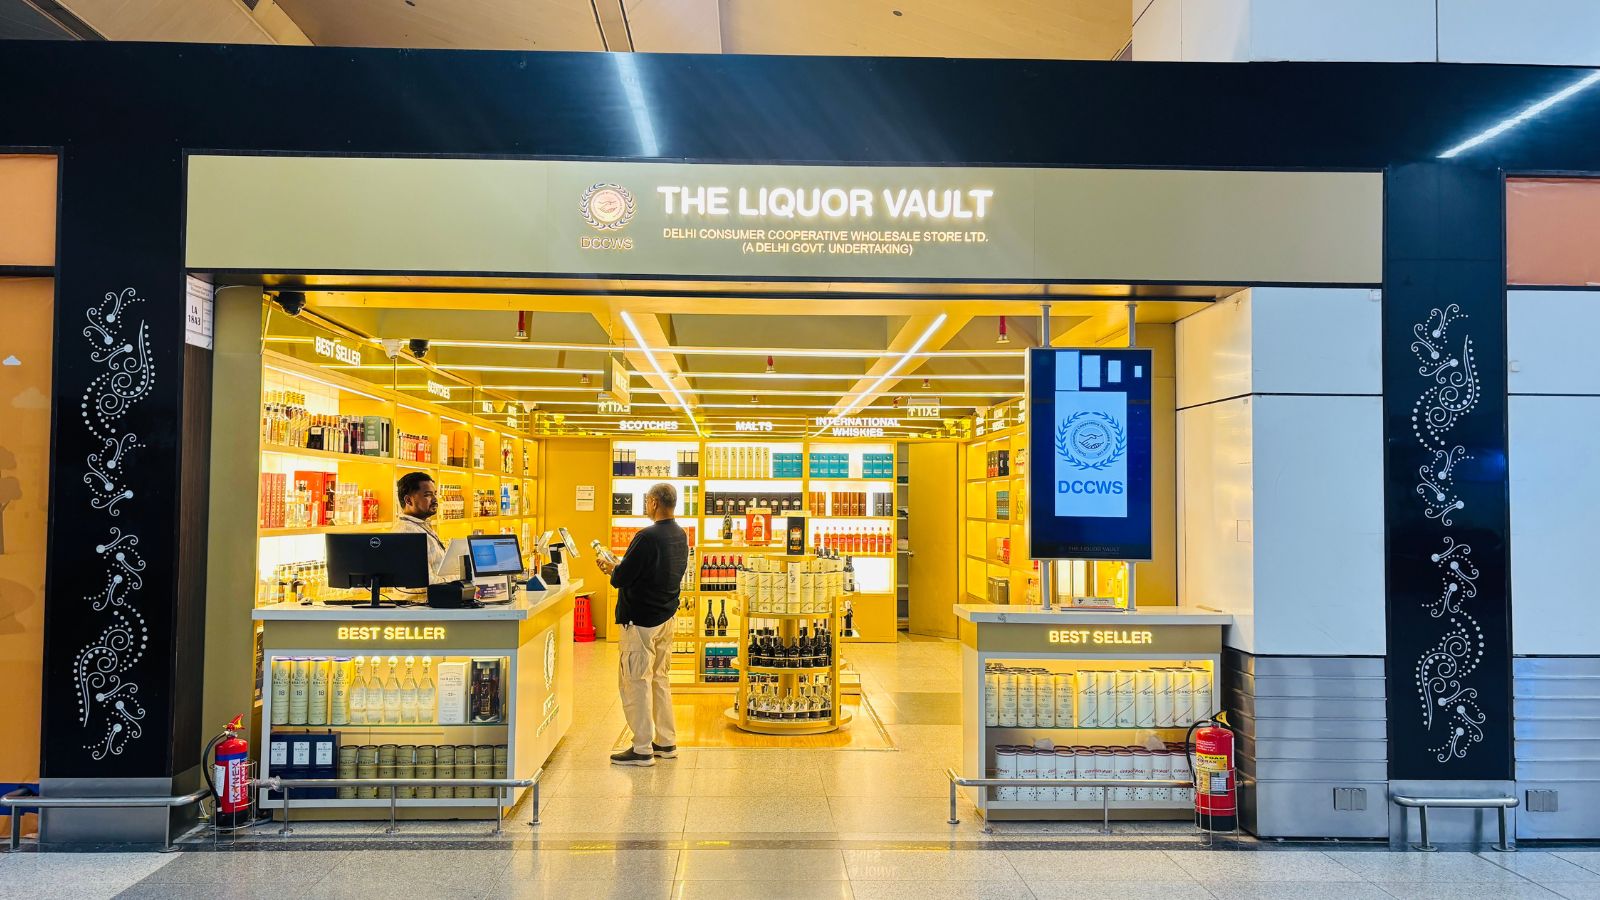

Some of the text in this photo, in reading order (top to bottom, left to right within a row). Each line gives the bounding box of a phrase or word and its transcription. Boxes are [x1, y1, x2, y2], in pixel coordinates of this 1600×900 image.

[657, 186, 730, 215] THE
[738, 187, 873, 218] LIQUOR
[883, 189, 993, 218] VAULT
[663, 228, 989, 243] DELHI CONSUMER COOPERATIVE WHOLESALE STORE LTD.
[581, 237, 633, 250] DCCWS
[742, 242, 914, 256] (A DELHI GOVT. UNDERTAKING)
[315, 336, 361, 368] BEST SELLER
[618, 420, 679, 431] SCOTCHES
[735, 421, 773, 431] MALTS
[815, 416, 901, 427] INTERNATIONAL
[832, 427, 884, 437] WHISKIES
[1058, 480, 1124, 495] DCCWS
[338, 626, 446, 640] BEST SELLER
[1049, 630, 1153, 644] BEST SELLER
